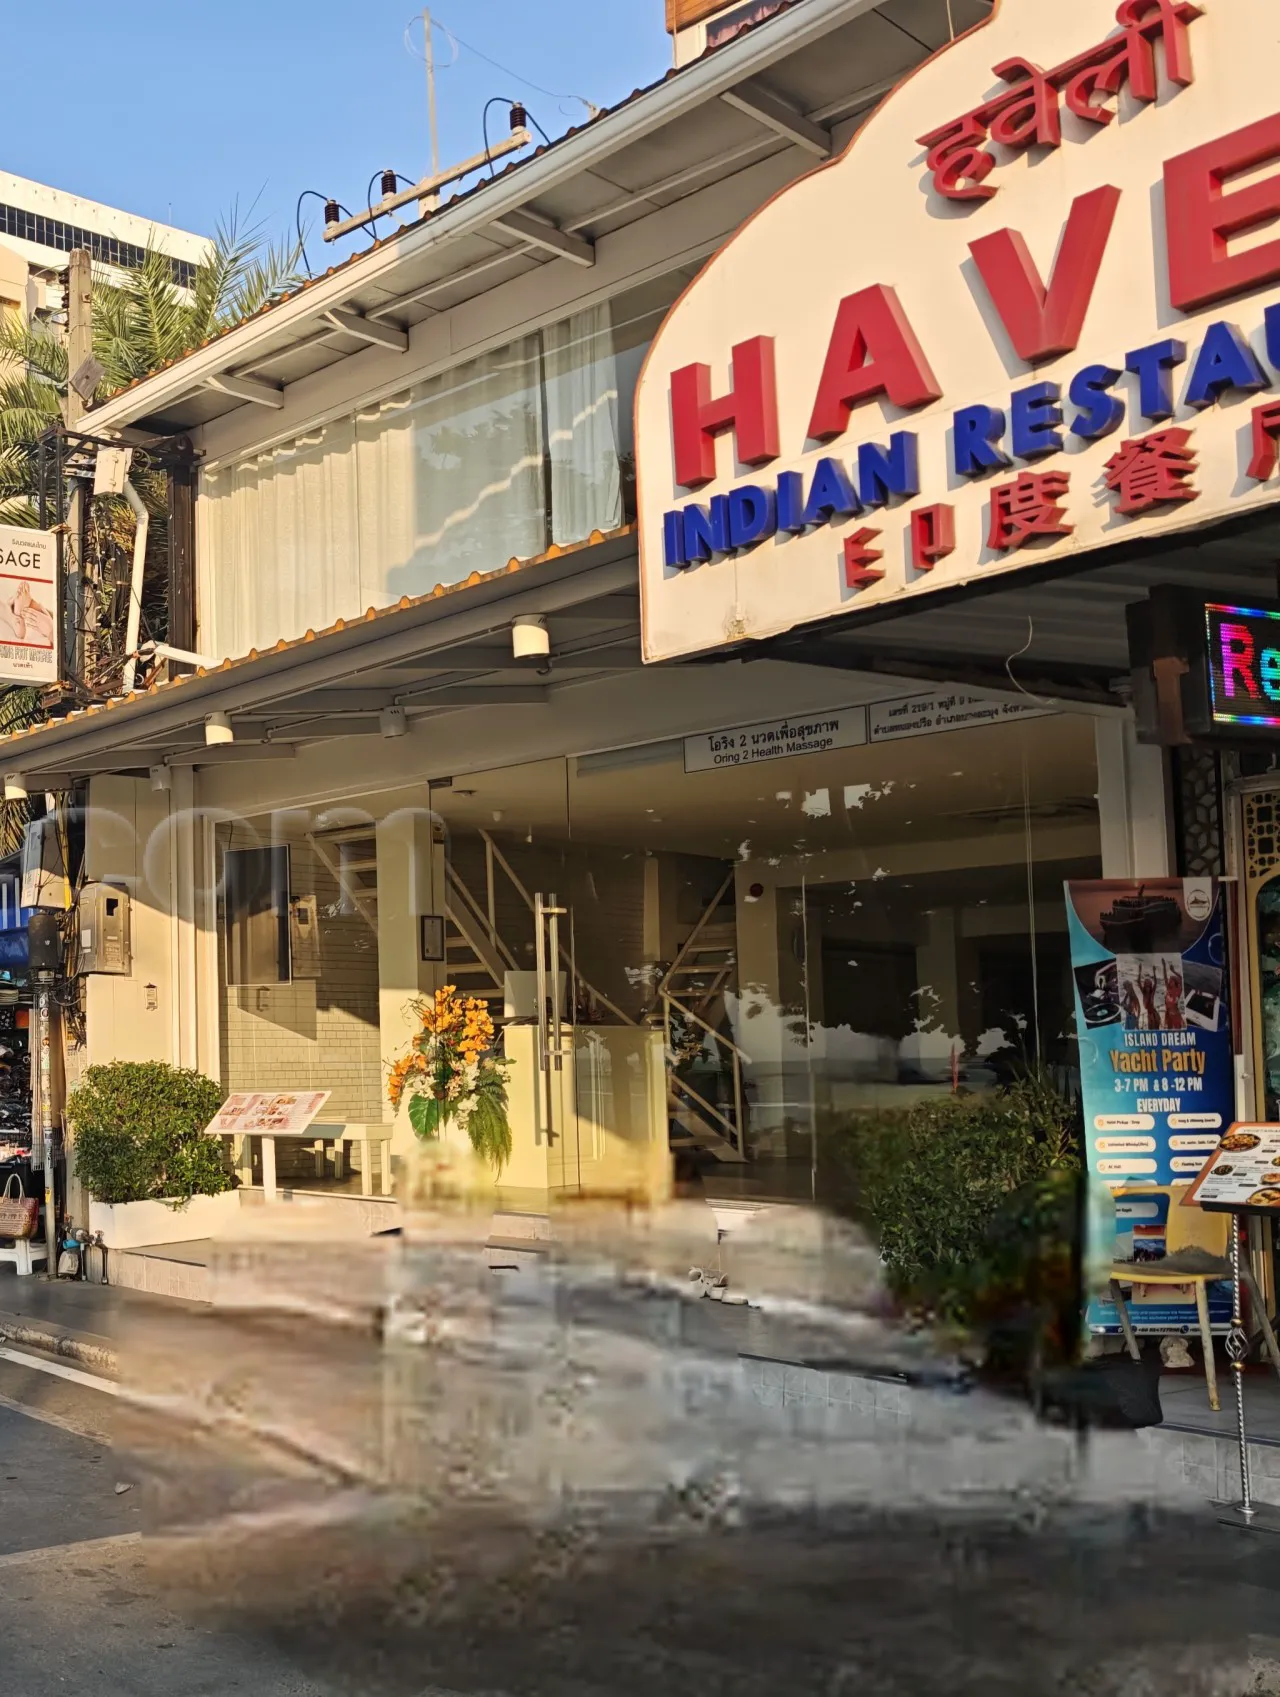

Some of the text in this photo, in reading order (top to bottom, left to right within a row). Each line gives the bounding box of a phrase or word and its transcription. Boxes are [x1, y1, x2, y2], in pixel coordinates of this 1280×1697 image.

[915, 0, 1205, 200] हवेली
[663, 431, 920, 569] INDIAN
[740, 734, 747, 746] 2
[714, 737, 834, 765] Oring 2 Health Massage
[1124, 1032, 1196, 1046] ISLAND DREAM
[1110, 1048, 1205, 1074] Yacht Party
[1114, 1078, 1130, 1092] 3-7
[1133, 1078, 1148, 1092] PM
[1153, 1080, 1160, 1092] &
[1187, 1077, 1202, 1091] PM
[1137, 1097, 1181, 1112] EVERYDAY
